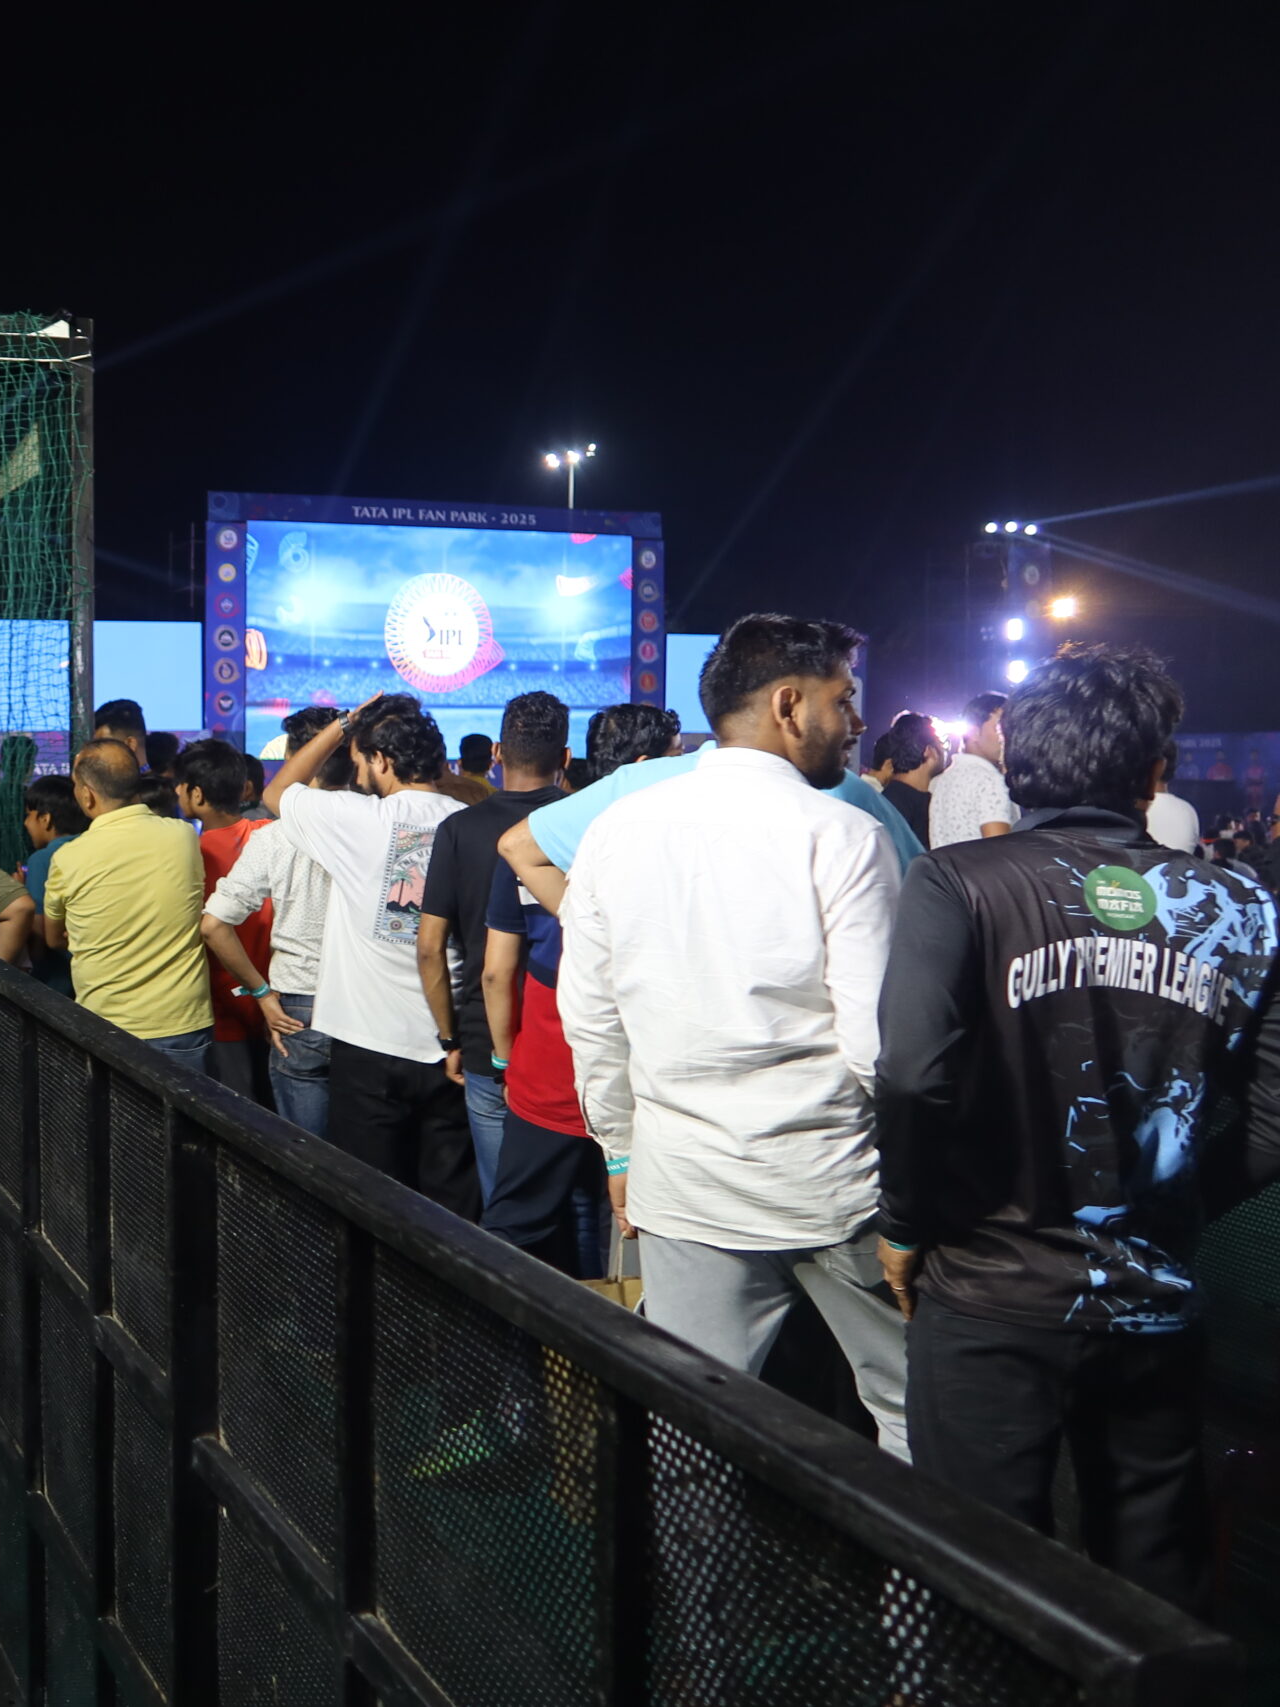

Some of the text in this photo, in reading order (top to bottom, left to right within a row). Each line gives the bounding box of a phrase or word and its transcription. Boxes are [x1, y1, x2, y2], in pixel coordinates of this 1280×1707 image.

[352, 505, 537, 526] TATA IPL FAN PARK 2025
[1095, 886, 1143, 900] MOMOS
[1096, 898, 1145, 913] MAFIA
[1007, 936, 1233, 1027] GULLY PREMIER LEAGUE
